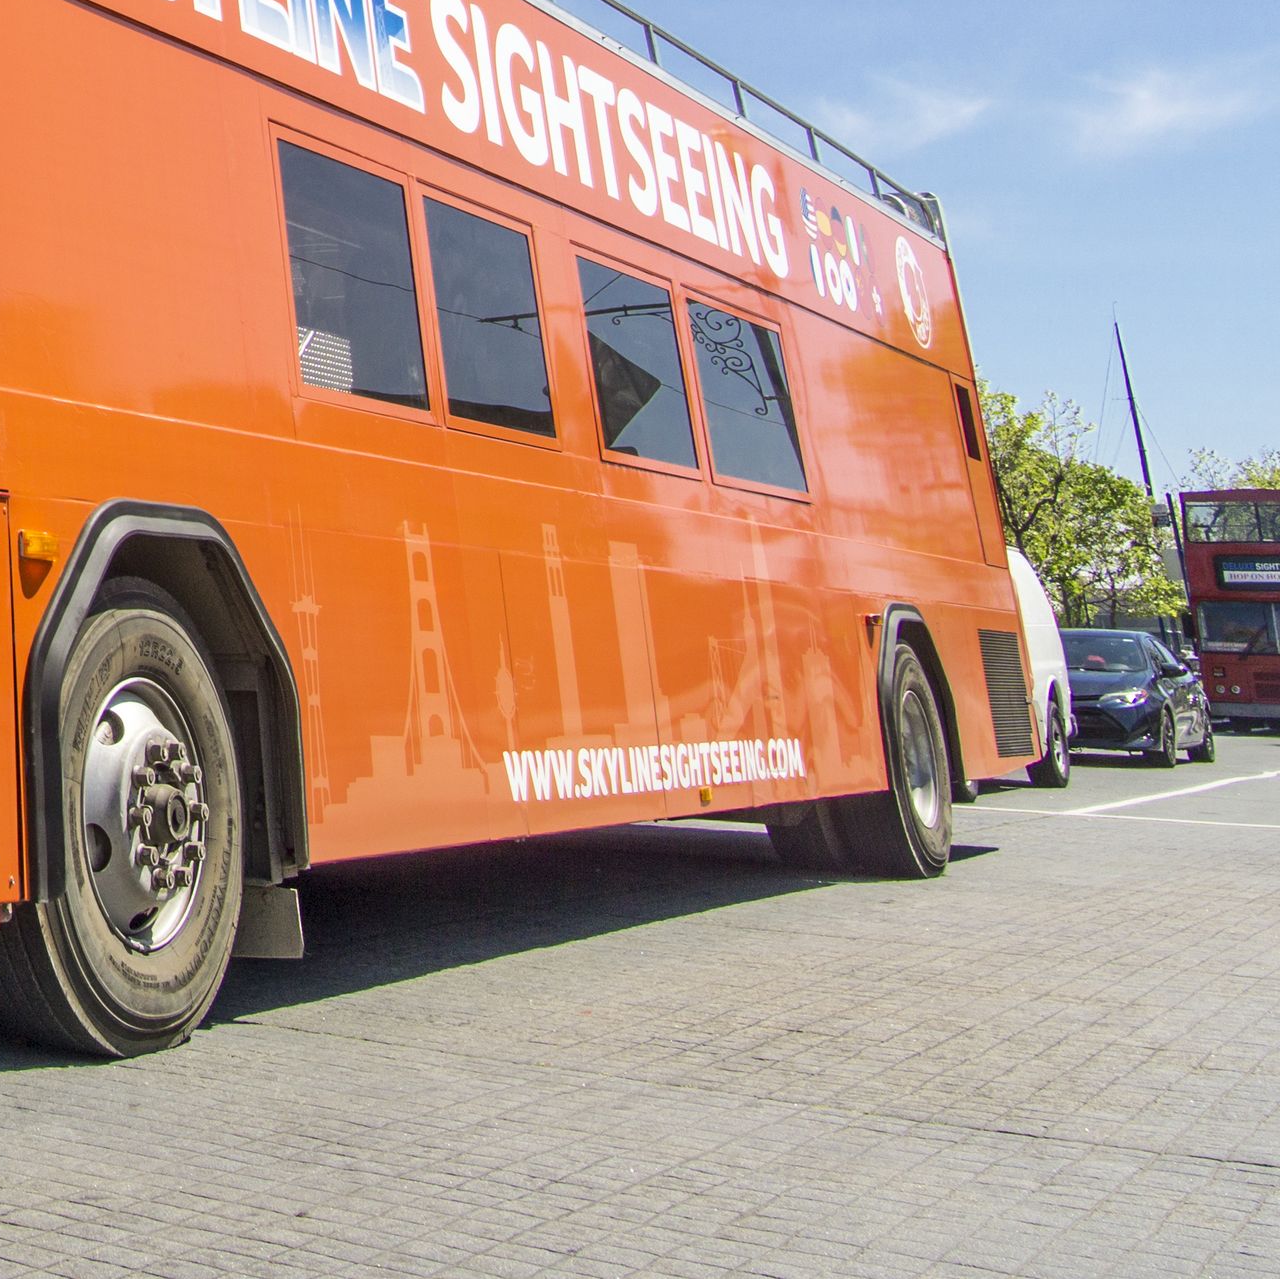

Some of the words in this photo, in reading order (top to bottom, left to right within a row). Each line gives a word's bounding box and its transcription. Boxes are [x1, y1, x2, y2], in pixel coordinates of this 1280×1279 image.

[1222, 562, 1254, 570] DELUXE
[1255, 563, 1280, 571] SIGHT
[1266, 573, 1280, 581] HO
[502, 738, 806, 802] WWW.SKYLINESIGHTSEEING.COM
